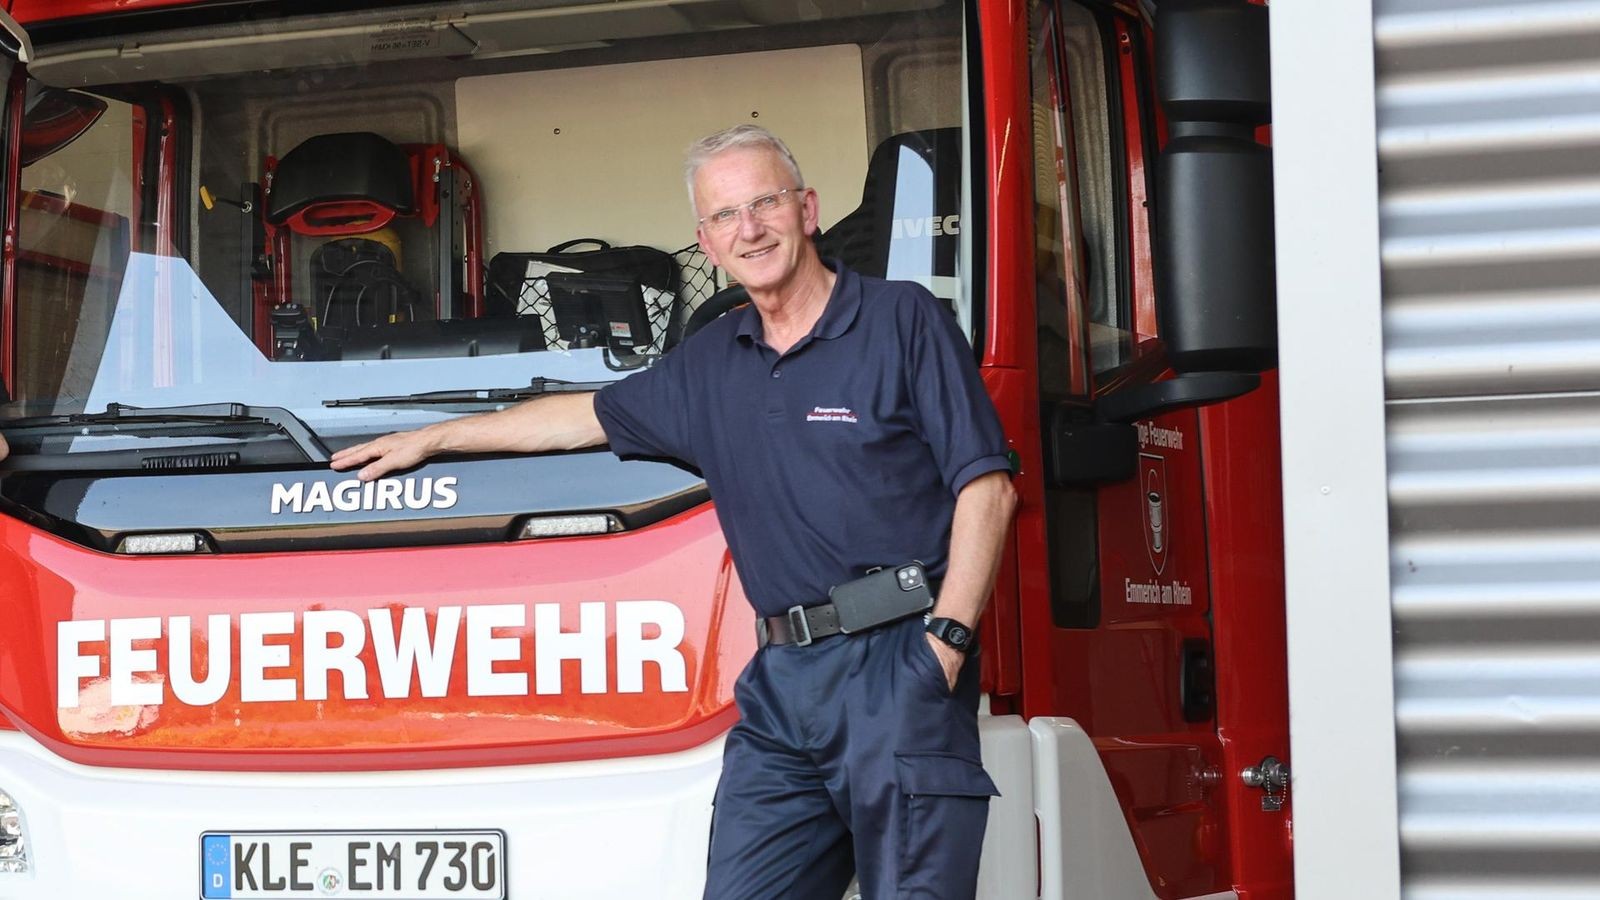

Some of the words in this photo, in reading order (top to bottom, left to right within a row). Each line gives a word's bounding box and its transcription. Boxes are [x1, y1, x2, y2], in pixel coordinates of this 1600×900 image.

[893, 215, 961, 239] IVEC
[1149, 421, 1183, 450] Feuerwehr
[270, 476, 458, 514] MAGIRUS
[1125, 577, 1161, 604] Emmerich
[1161, 584, 1173, 604] am
[1172, 580, 1192, 605] Rhein
[57, 600, 689, 708] FEUERWEHR
[213, 873, 223, 888] D
[234, 842, 314, 891] KLE
[348, 841, 401, 891] EM
[415, 841, 495, 891] 730
